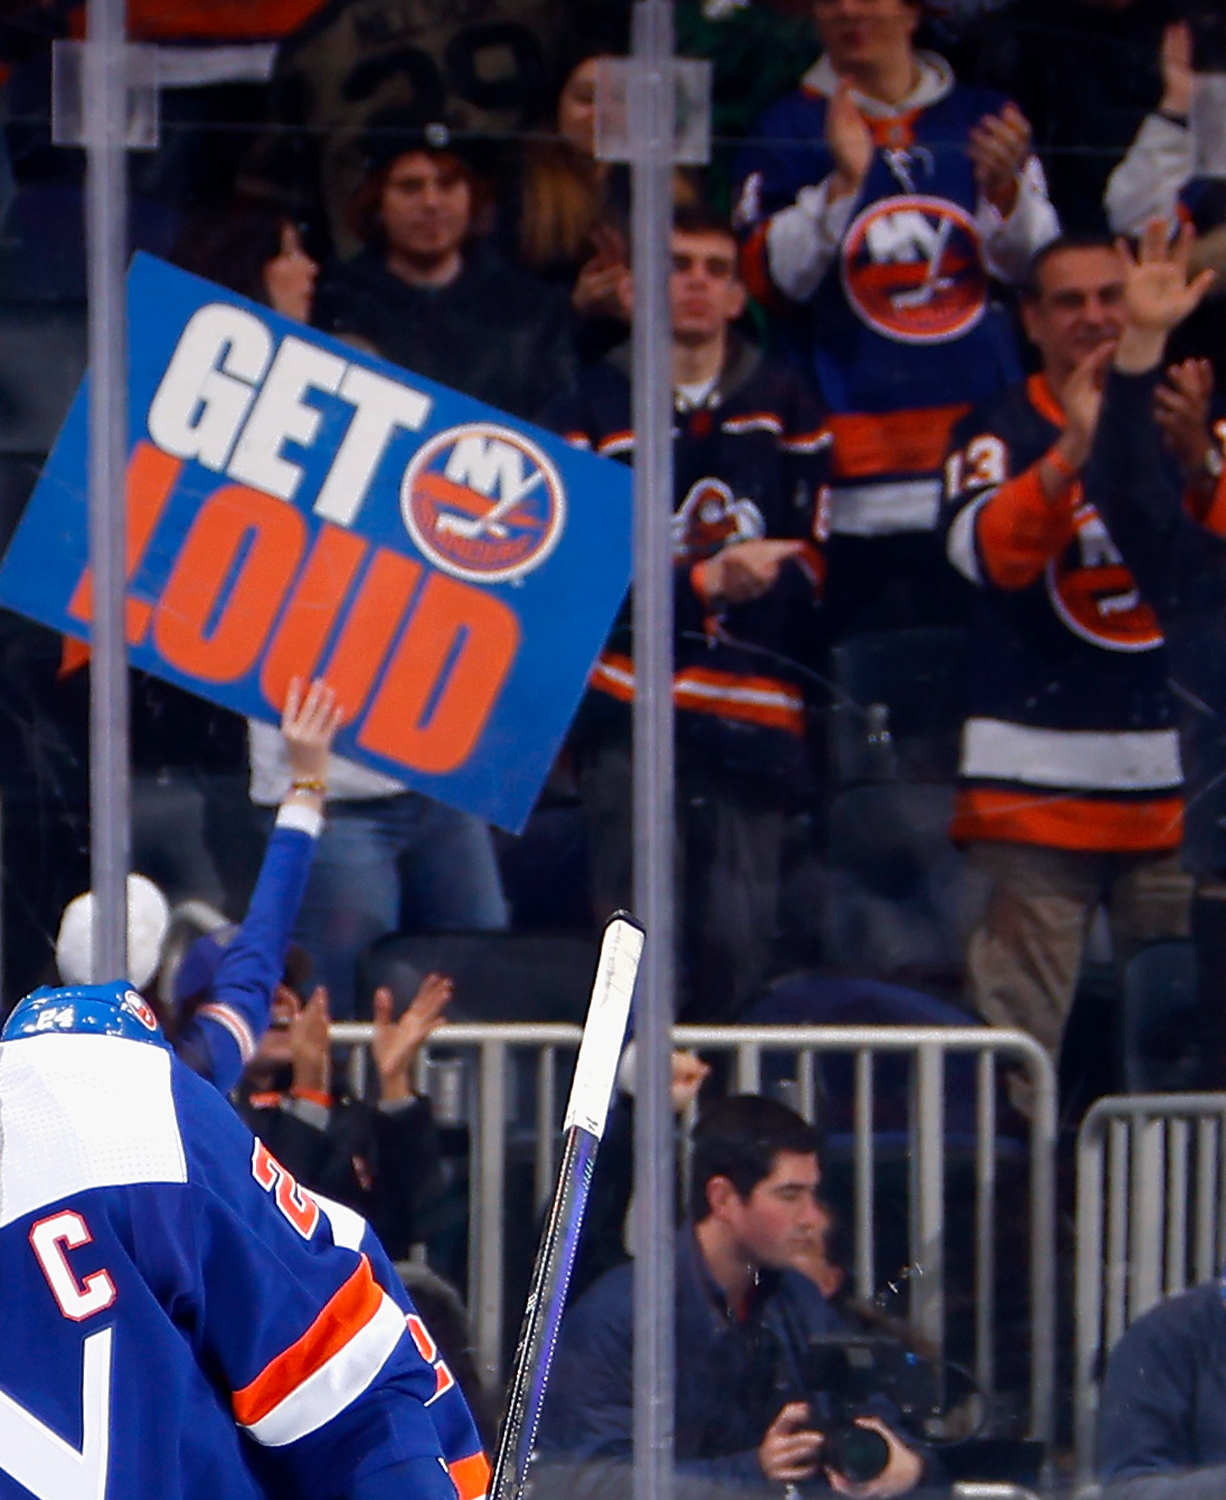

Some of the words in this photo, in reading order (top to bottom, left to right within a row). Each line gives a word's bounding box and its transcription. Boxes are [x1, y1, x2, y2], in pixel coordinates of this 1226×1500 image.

[148, 303, 431, 527] GET
[944, 433, 1009, 499] 13
[66, 440, 521, 775] LOUD
[36, 1007, 75, 1032] 24
[29, 1209, 117, 1322] C
